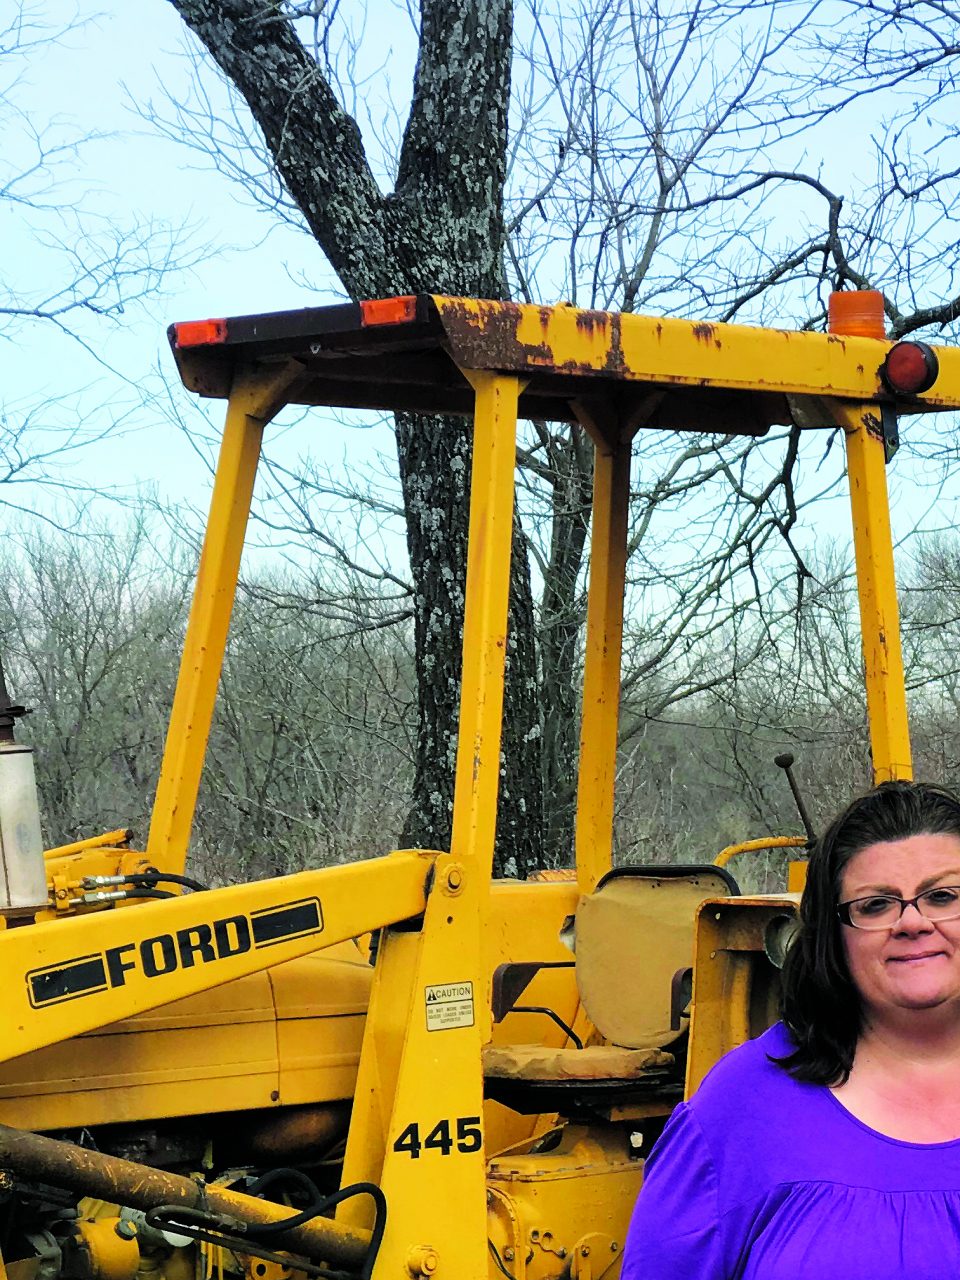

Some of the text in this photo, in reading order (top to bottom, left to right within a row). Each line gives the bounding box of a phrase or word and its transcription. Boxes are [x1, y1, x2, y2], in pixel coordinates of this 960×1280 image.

[105, 914, 251, 988] FORD
[436, 987, 471, 999] CAUTION
[393, 1116, 482, 1159] 445
